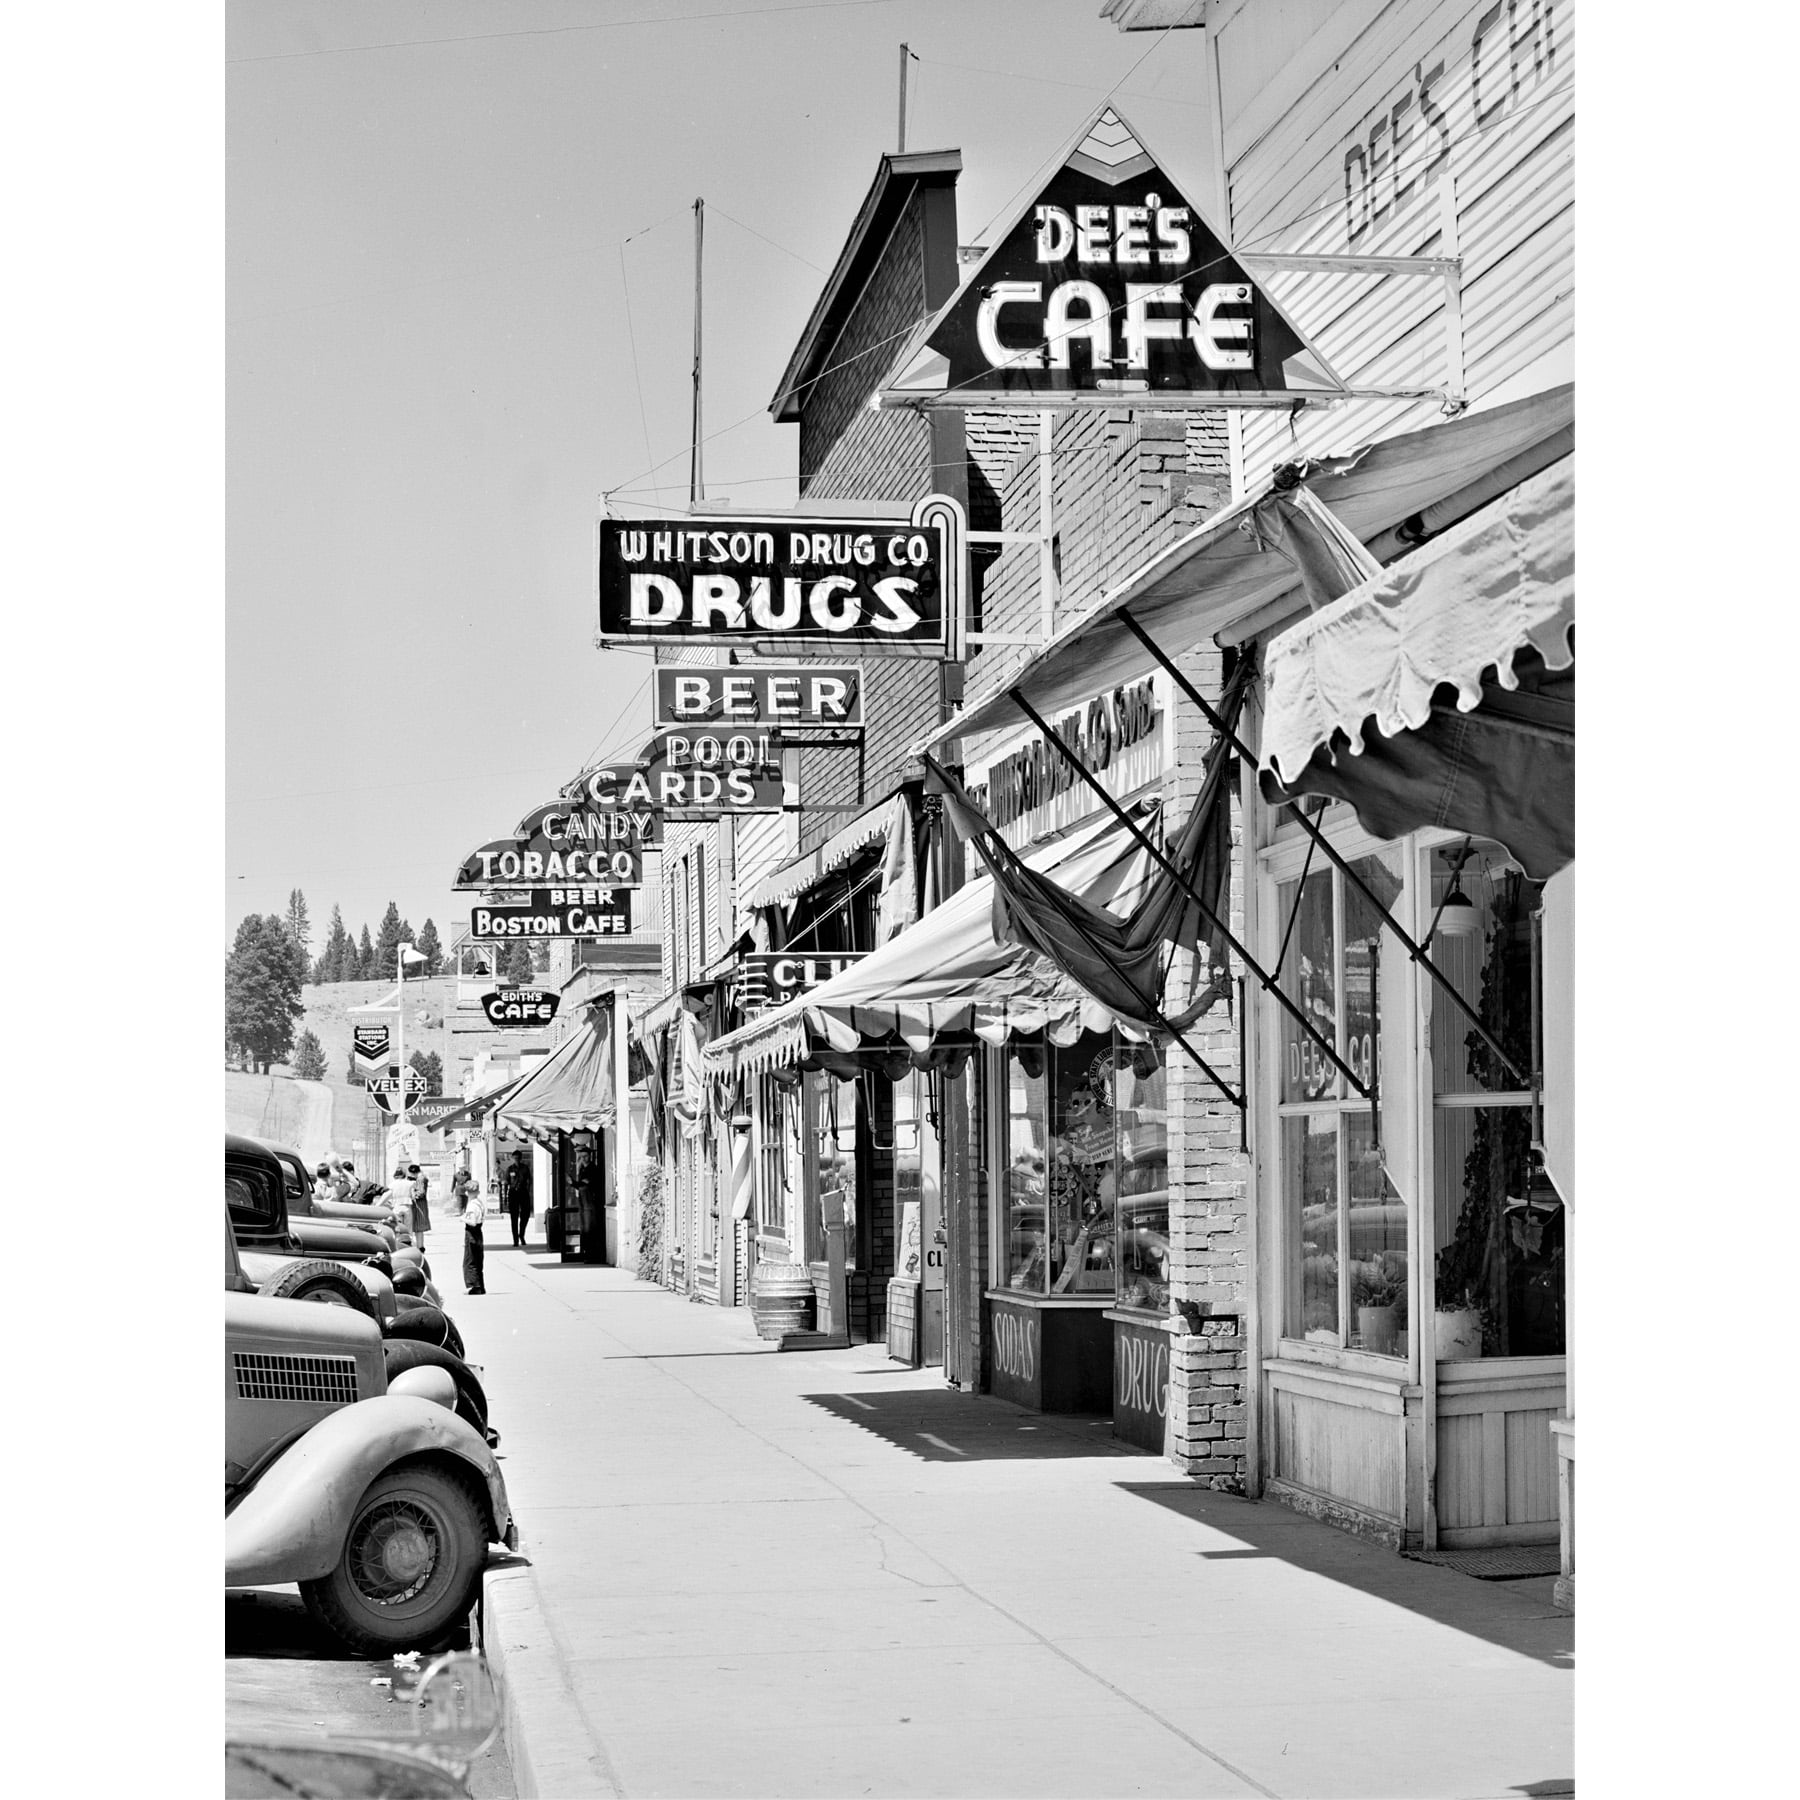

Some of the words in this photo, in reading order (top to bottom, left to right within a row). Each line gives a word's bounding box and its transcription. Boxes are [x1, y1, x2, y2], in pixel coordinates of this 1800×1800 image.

[1036, 193, 1191, 264] DEE'S
[977, 280, 1254, 370] CAFE
[619, 531, 773, 563] WHITSON
[790, 533, 876, 566] DRUG
[887, 535, 929, 567] CO
[630, 574, 922, 633] DRUGS
[674, 676, 848, 716] BEER
[666, 736, 779, 766] POOL
[588, 769, 755, 804] CARDS
[542, 812, 651, 840] CANDY
[475, 851, 633, 879] TOBACCO
[550, 889, 615, 905] BEER
[477, 910, 560, 935] BOSTON
[567, 909, 626, 934] CAFE
[489, 1000, 551, 1019] CAFE
[501, 992, 543, 1002] EDITH'S
[994, 1311, 1034, 1382] SODAS
[1120, 1335, 1169, 1418] DRUG
